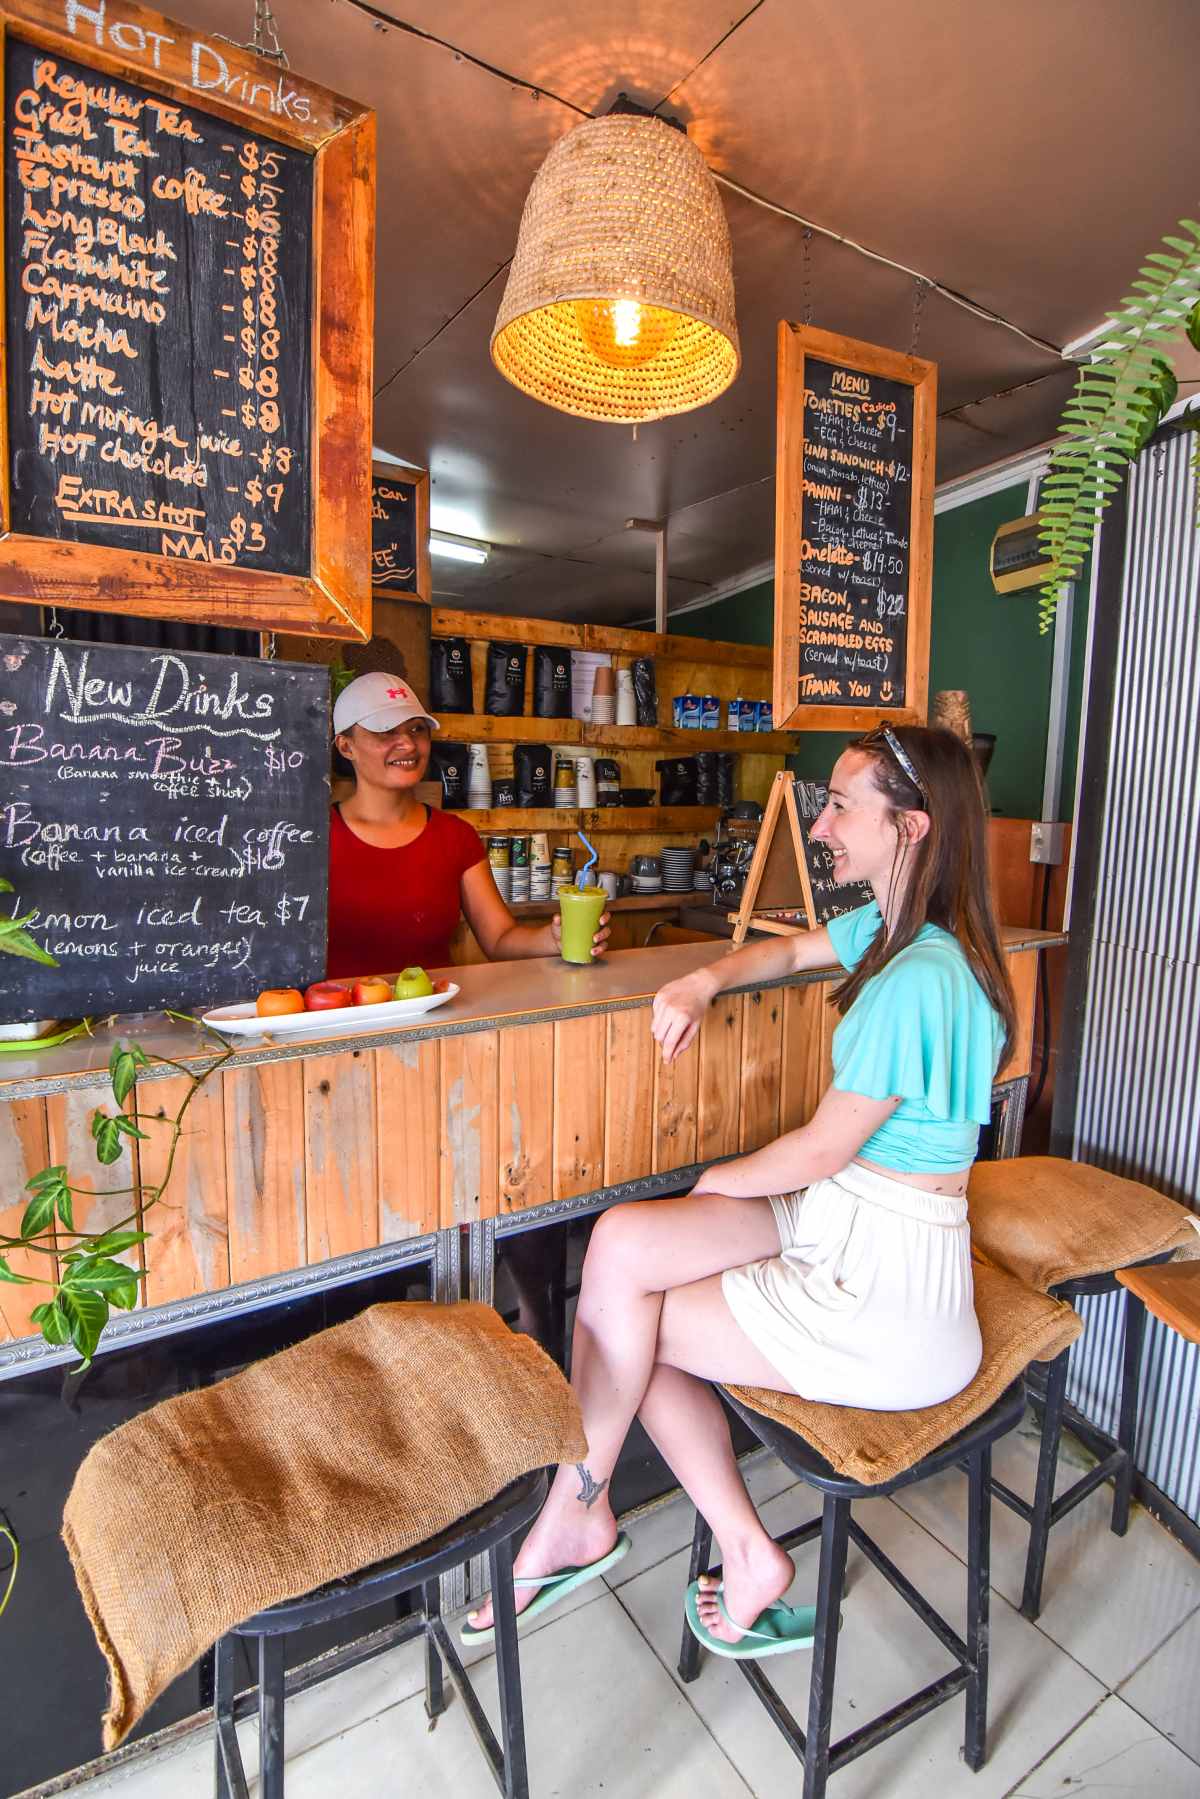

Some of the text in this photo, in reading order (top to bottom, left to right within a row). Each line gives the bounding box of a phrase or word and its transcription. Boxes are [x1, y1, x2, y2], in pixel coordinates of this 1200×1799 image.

[831, 371, 870, 394] MENU
[831, 448, 884, 477] SANDWICH
[229, 511, 266, 552] $3
[859, 618, 884, 634] AND
[45, 647, 133, 716] New
[799, 672, 871, 698] THANK YOU
[0, 723, 147, 765] Banana
[264, 742, 304, 777] $10
[3, 803, 150, 848] Banana
[174, 814, 229, 846] iced
[96, 862, 155, 879] vanilla
[136, 896, 202, 927] iced
[274, 893, 310, 926] $7
[127, 961, 180, 983] juice
